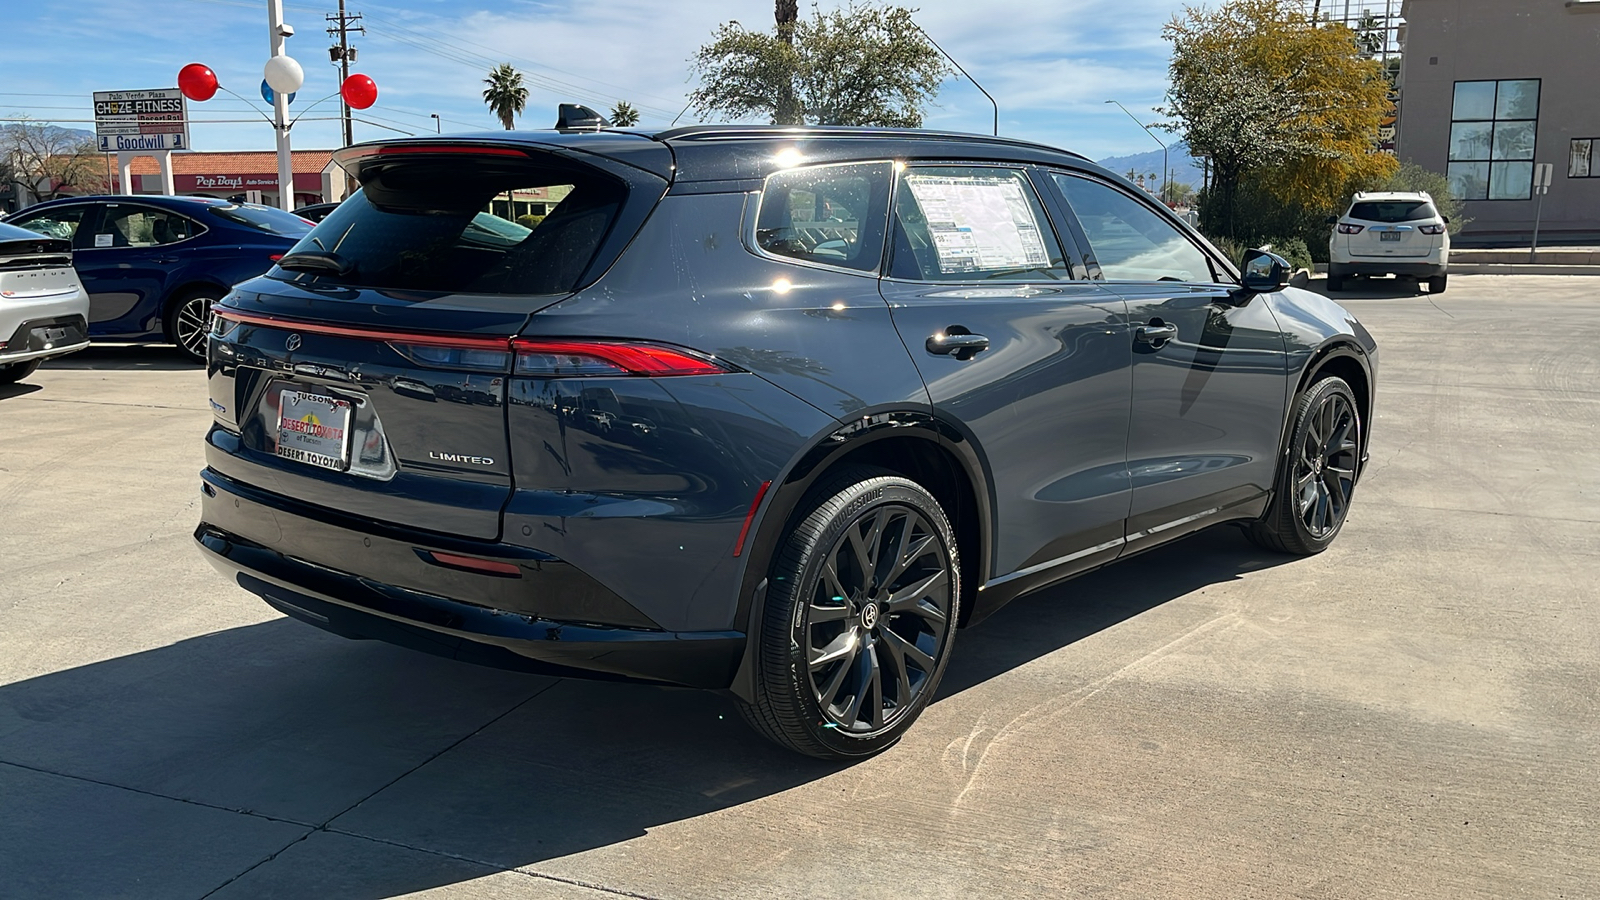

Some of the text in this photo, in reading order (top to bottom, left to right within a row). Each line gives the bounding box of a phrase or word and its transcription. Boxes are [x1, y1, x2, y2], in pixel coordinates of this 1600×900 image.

[148, 91, 166, 99] Plaza
[136, 99, 181, 113] FITNESS
[116, 134, 165, 149] Goodwill
[195, 175, 243, 189] Pep Boys
[297, 392, 331, 405] TUCSON
[282, 417, 344, 440] DESERT TOYOTA
[303, 435, 322, 446] Tucson
[277, 446, 341, 470] DESERT TOYOTA
[429, 451, 494, 465] LIMITED
